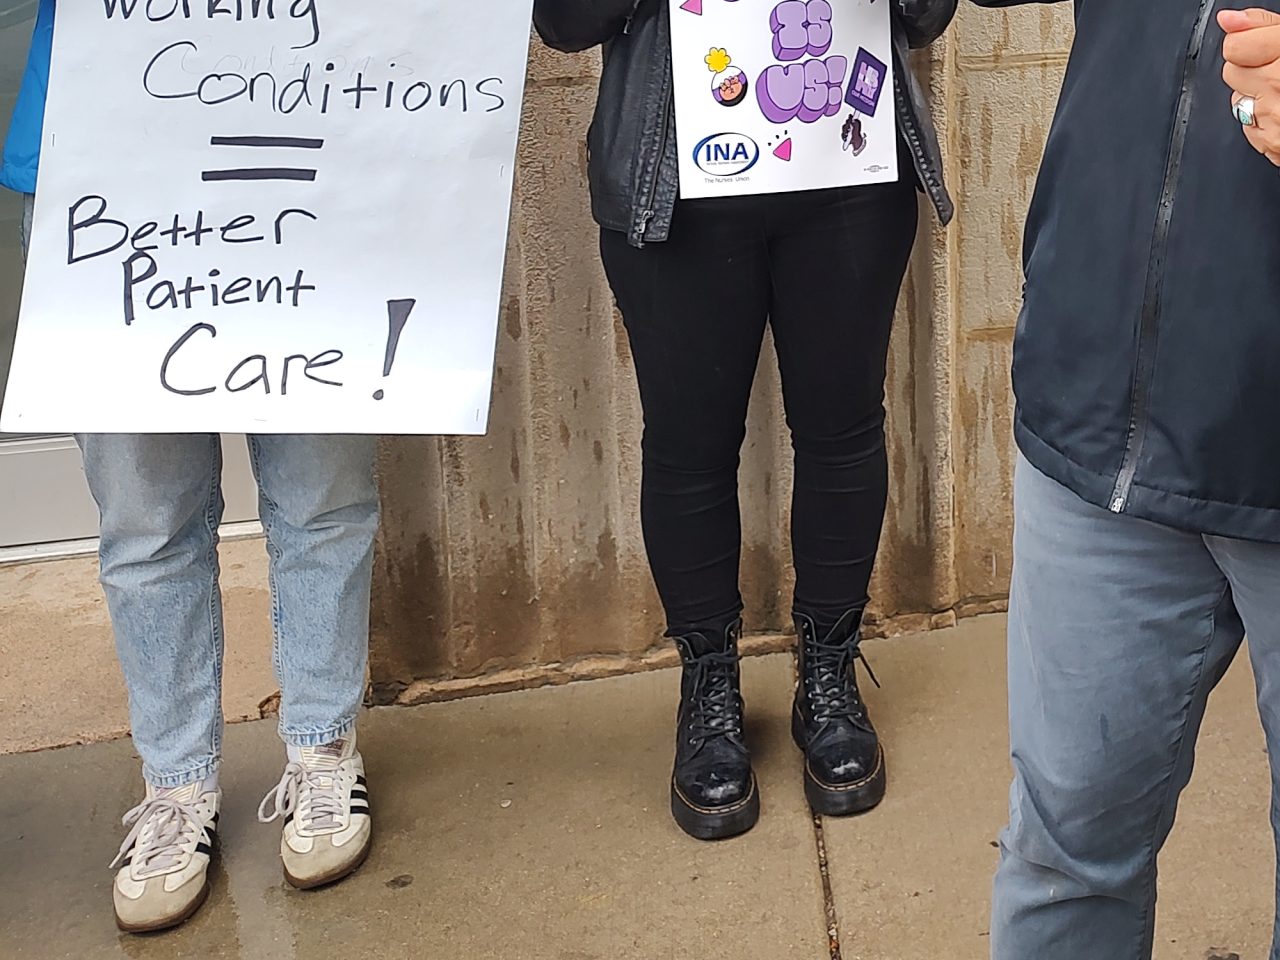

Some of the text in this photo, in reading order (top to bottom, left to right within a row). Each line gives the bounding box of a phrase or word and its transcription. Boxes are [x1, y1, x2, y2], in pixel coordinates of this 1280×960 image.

[142, 40, 505, 115] Conditions
[755, 55, 848, 124] US!
[706, 142, 749, 161] INA
[67, 195, 318, 265] Better
[121, 249, 316, 326] Patient
